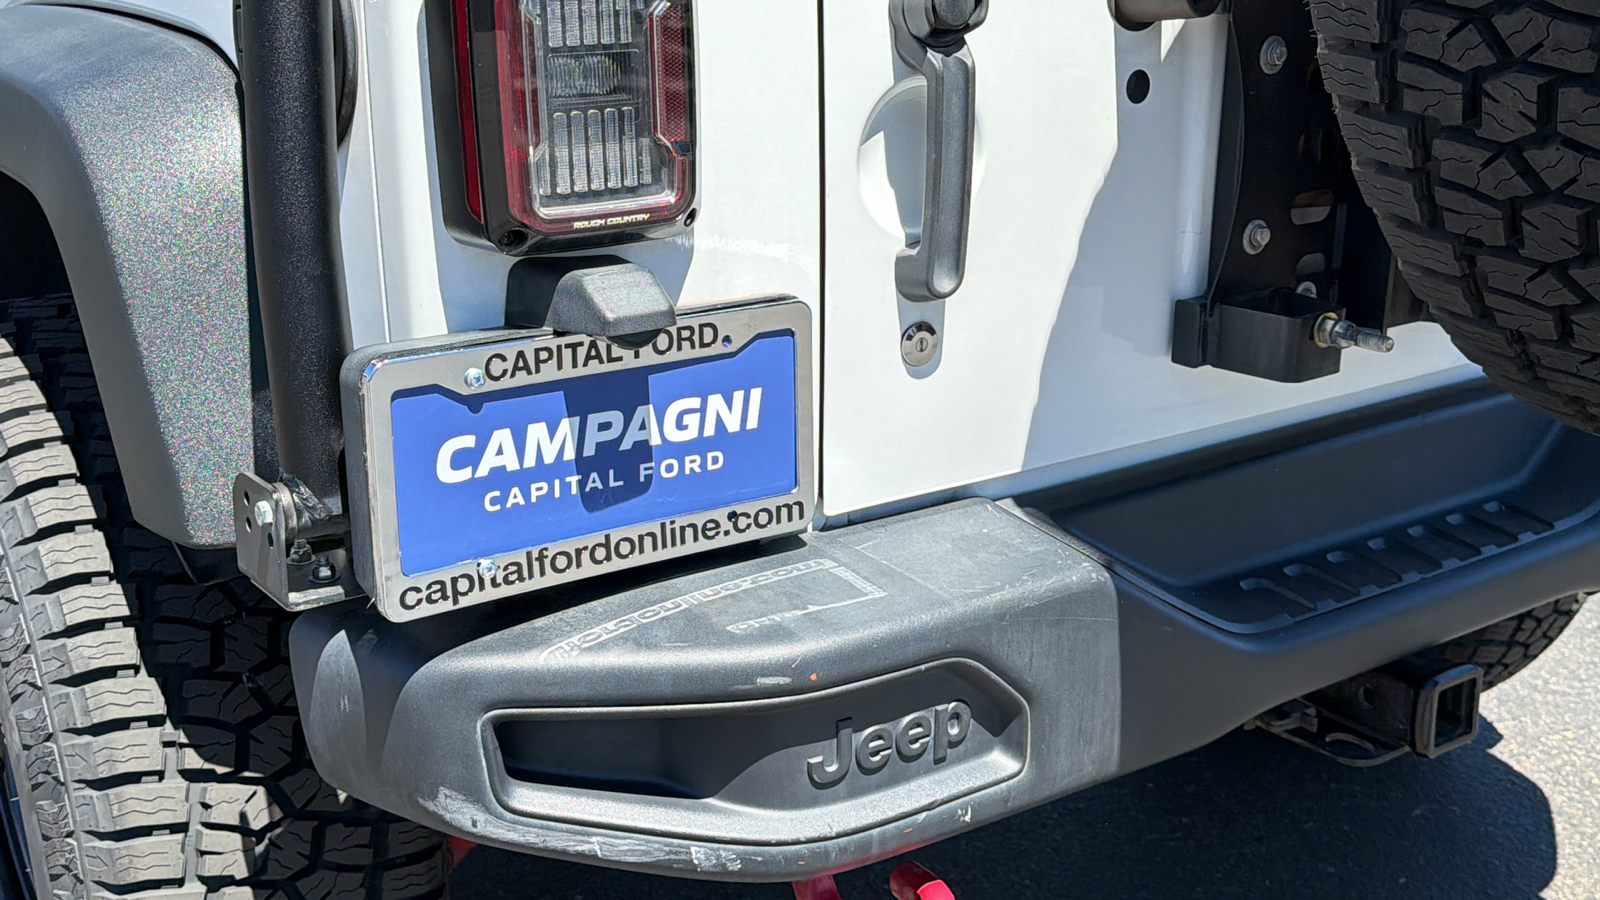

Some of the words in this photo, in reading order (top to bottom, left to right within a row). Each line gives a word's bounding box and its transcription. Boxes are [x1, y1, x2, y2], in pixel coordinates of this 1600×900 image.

[573, 219, 605, 229] ROUGH
[606, 213, 651, 225] COUNTRY
[485, 338, 623, 382] CAPITAL
[634, 322, 719, 360] ORD
[436, 387, 763, 484] CAMPAGNI
[484, 469, 624, 512] CAPITAL
[639, 450, 725, 482] FORD
[807, 699, 972, 790] Jeep
